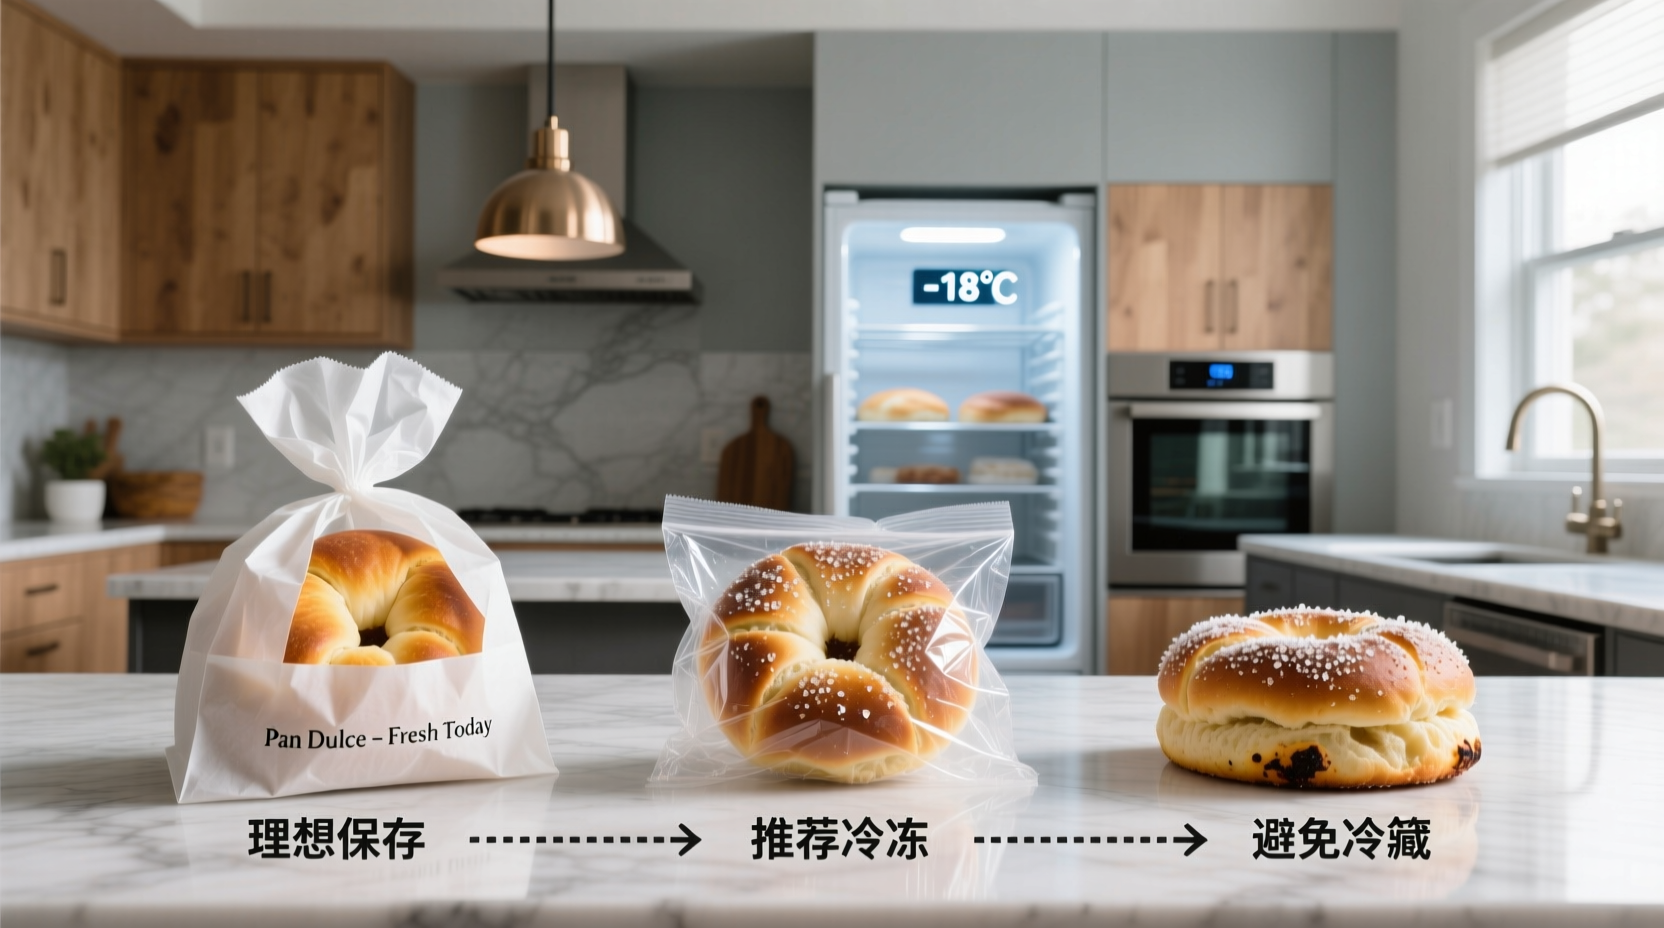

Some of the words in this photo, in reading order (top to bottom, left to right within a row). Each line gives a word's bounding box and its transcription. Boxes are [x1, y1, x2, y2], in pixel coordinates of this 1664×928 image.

[923, 269, 1018, 306] -18°C
[264, 726, 302, 749] Pan
[308, 729, 367, 750] Dulce
[388, 723, 438, 745] Fresh
[443, 717, 492, 739] Today
